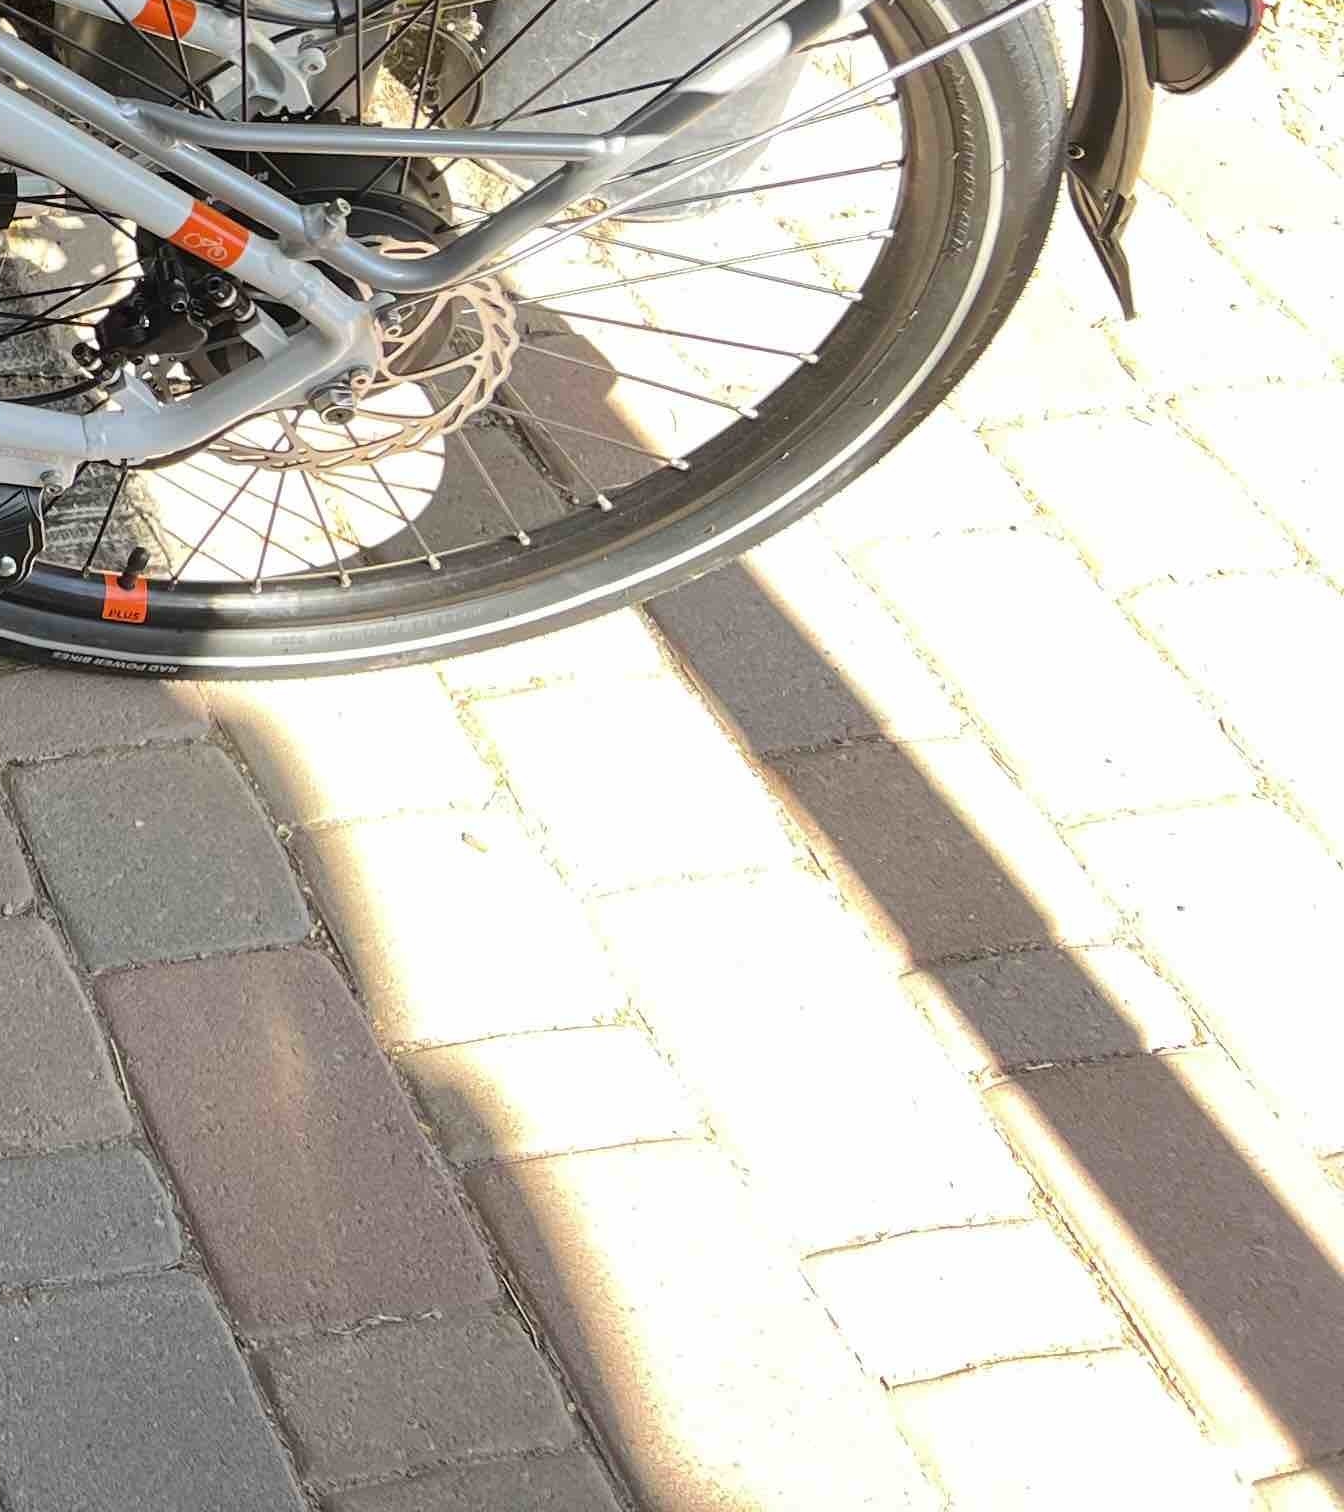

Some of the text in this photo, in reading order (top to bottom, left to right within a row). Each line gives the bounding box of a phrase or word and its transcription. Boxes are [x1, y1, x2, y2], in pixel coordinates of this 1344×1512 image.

[108, 609, 142, 621] PLUS
[51, 650, 180, 674] RAD POWER BIKES
